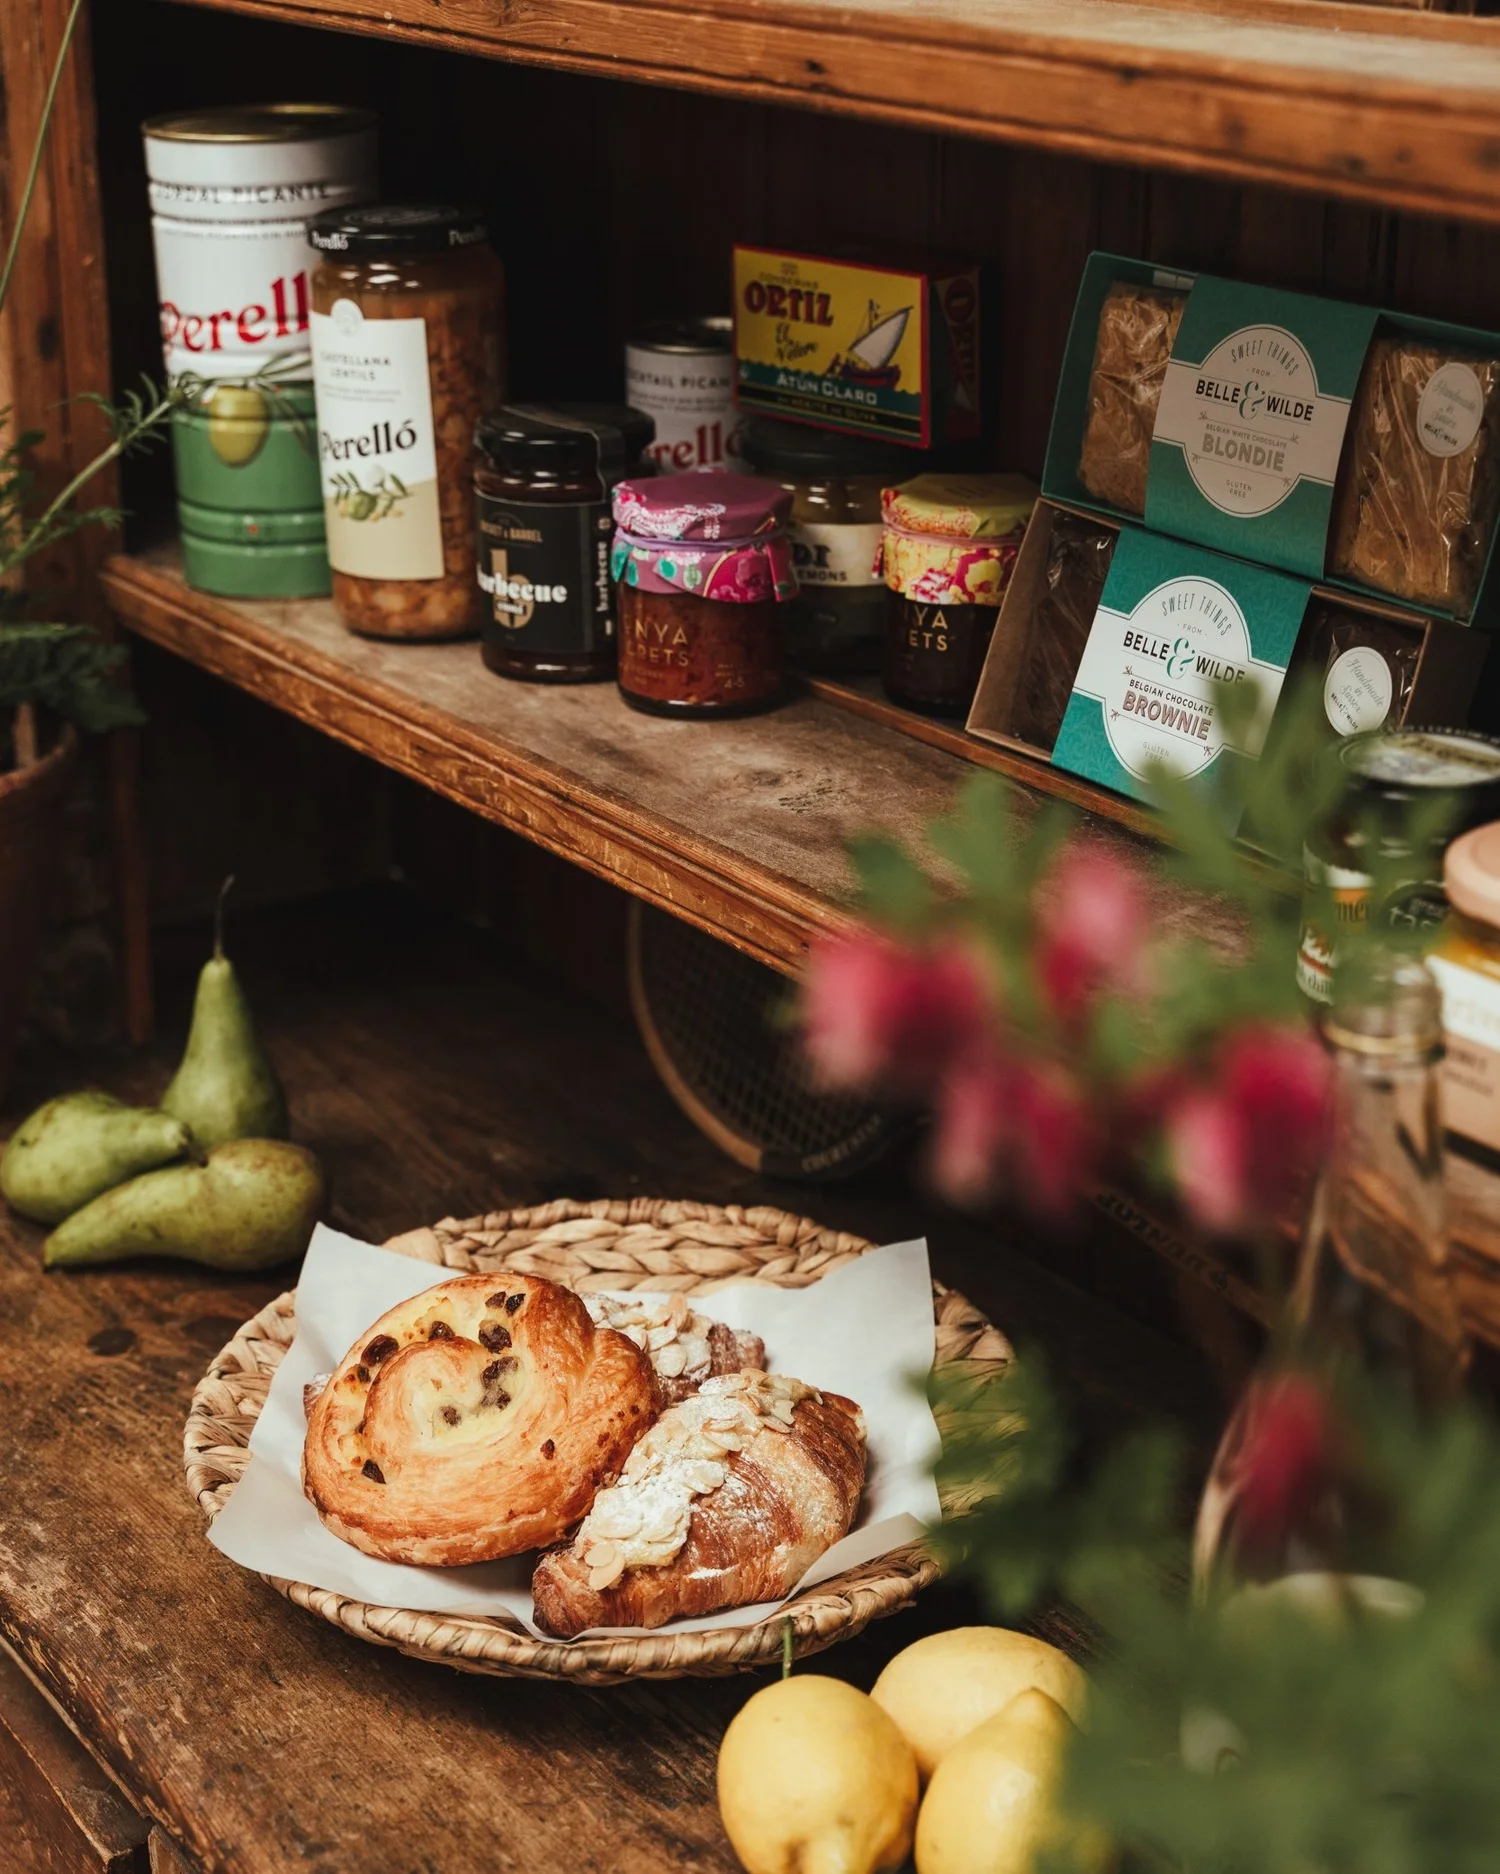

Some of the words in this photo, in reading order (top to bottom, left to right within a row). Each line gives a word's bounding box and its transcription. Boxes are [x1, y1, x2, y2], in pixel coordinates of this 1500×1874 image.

[231, 183, 329, 205] PICANTE
[159, 269, 310, 354] Perell
[744, 279, 834, 327] ORTIZ
[1231, 340, 1263, 363] SWEET
[1266, 341, 1299, 376] THINGS
[821, 380, 878, 406] CLARO
[1195, 379, 1241, 404] BELLE
[1239, 380, 1266, 420] &
[1267, 395, 1314, 421] WILDE
[320, 419, 417, 461] Perelló
[645, 419, 748, 469] relló
[1202, 432, 1285, 472] BLONDIE
[1205, 423, 1231, 434] BELGIAN
[1232, 430, 1251, 440] WHITE
[1252, 435, 1288, 449] CHOCOLATE
[796, 568, 848, 582] EMONS
[624, 614, 688, 645] NYA
[912, 603, 949, 630] YA
[1162, 593, 1195, 616] SWEET
[1199, 596, 1232, 636] THINGS
[1182, 623, 1203, 636] FROM
[909, 629, 949, 652] ETS
[1123, 630, 1170, 660] BELLE
[1166, 637, 1196, 680] &
[1129, 678, 1164, 698] BELGIAN
[1165, 692, 1215, 716] CHOCOLATE
[1346, 658, 1385, 708] Handmade
[1122, 690, 1212, 741] BROWNIE
[1142, 741, 1170, 757] GLUTEN
